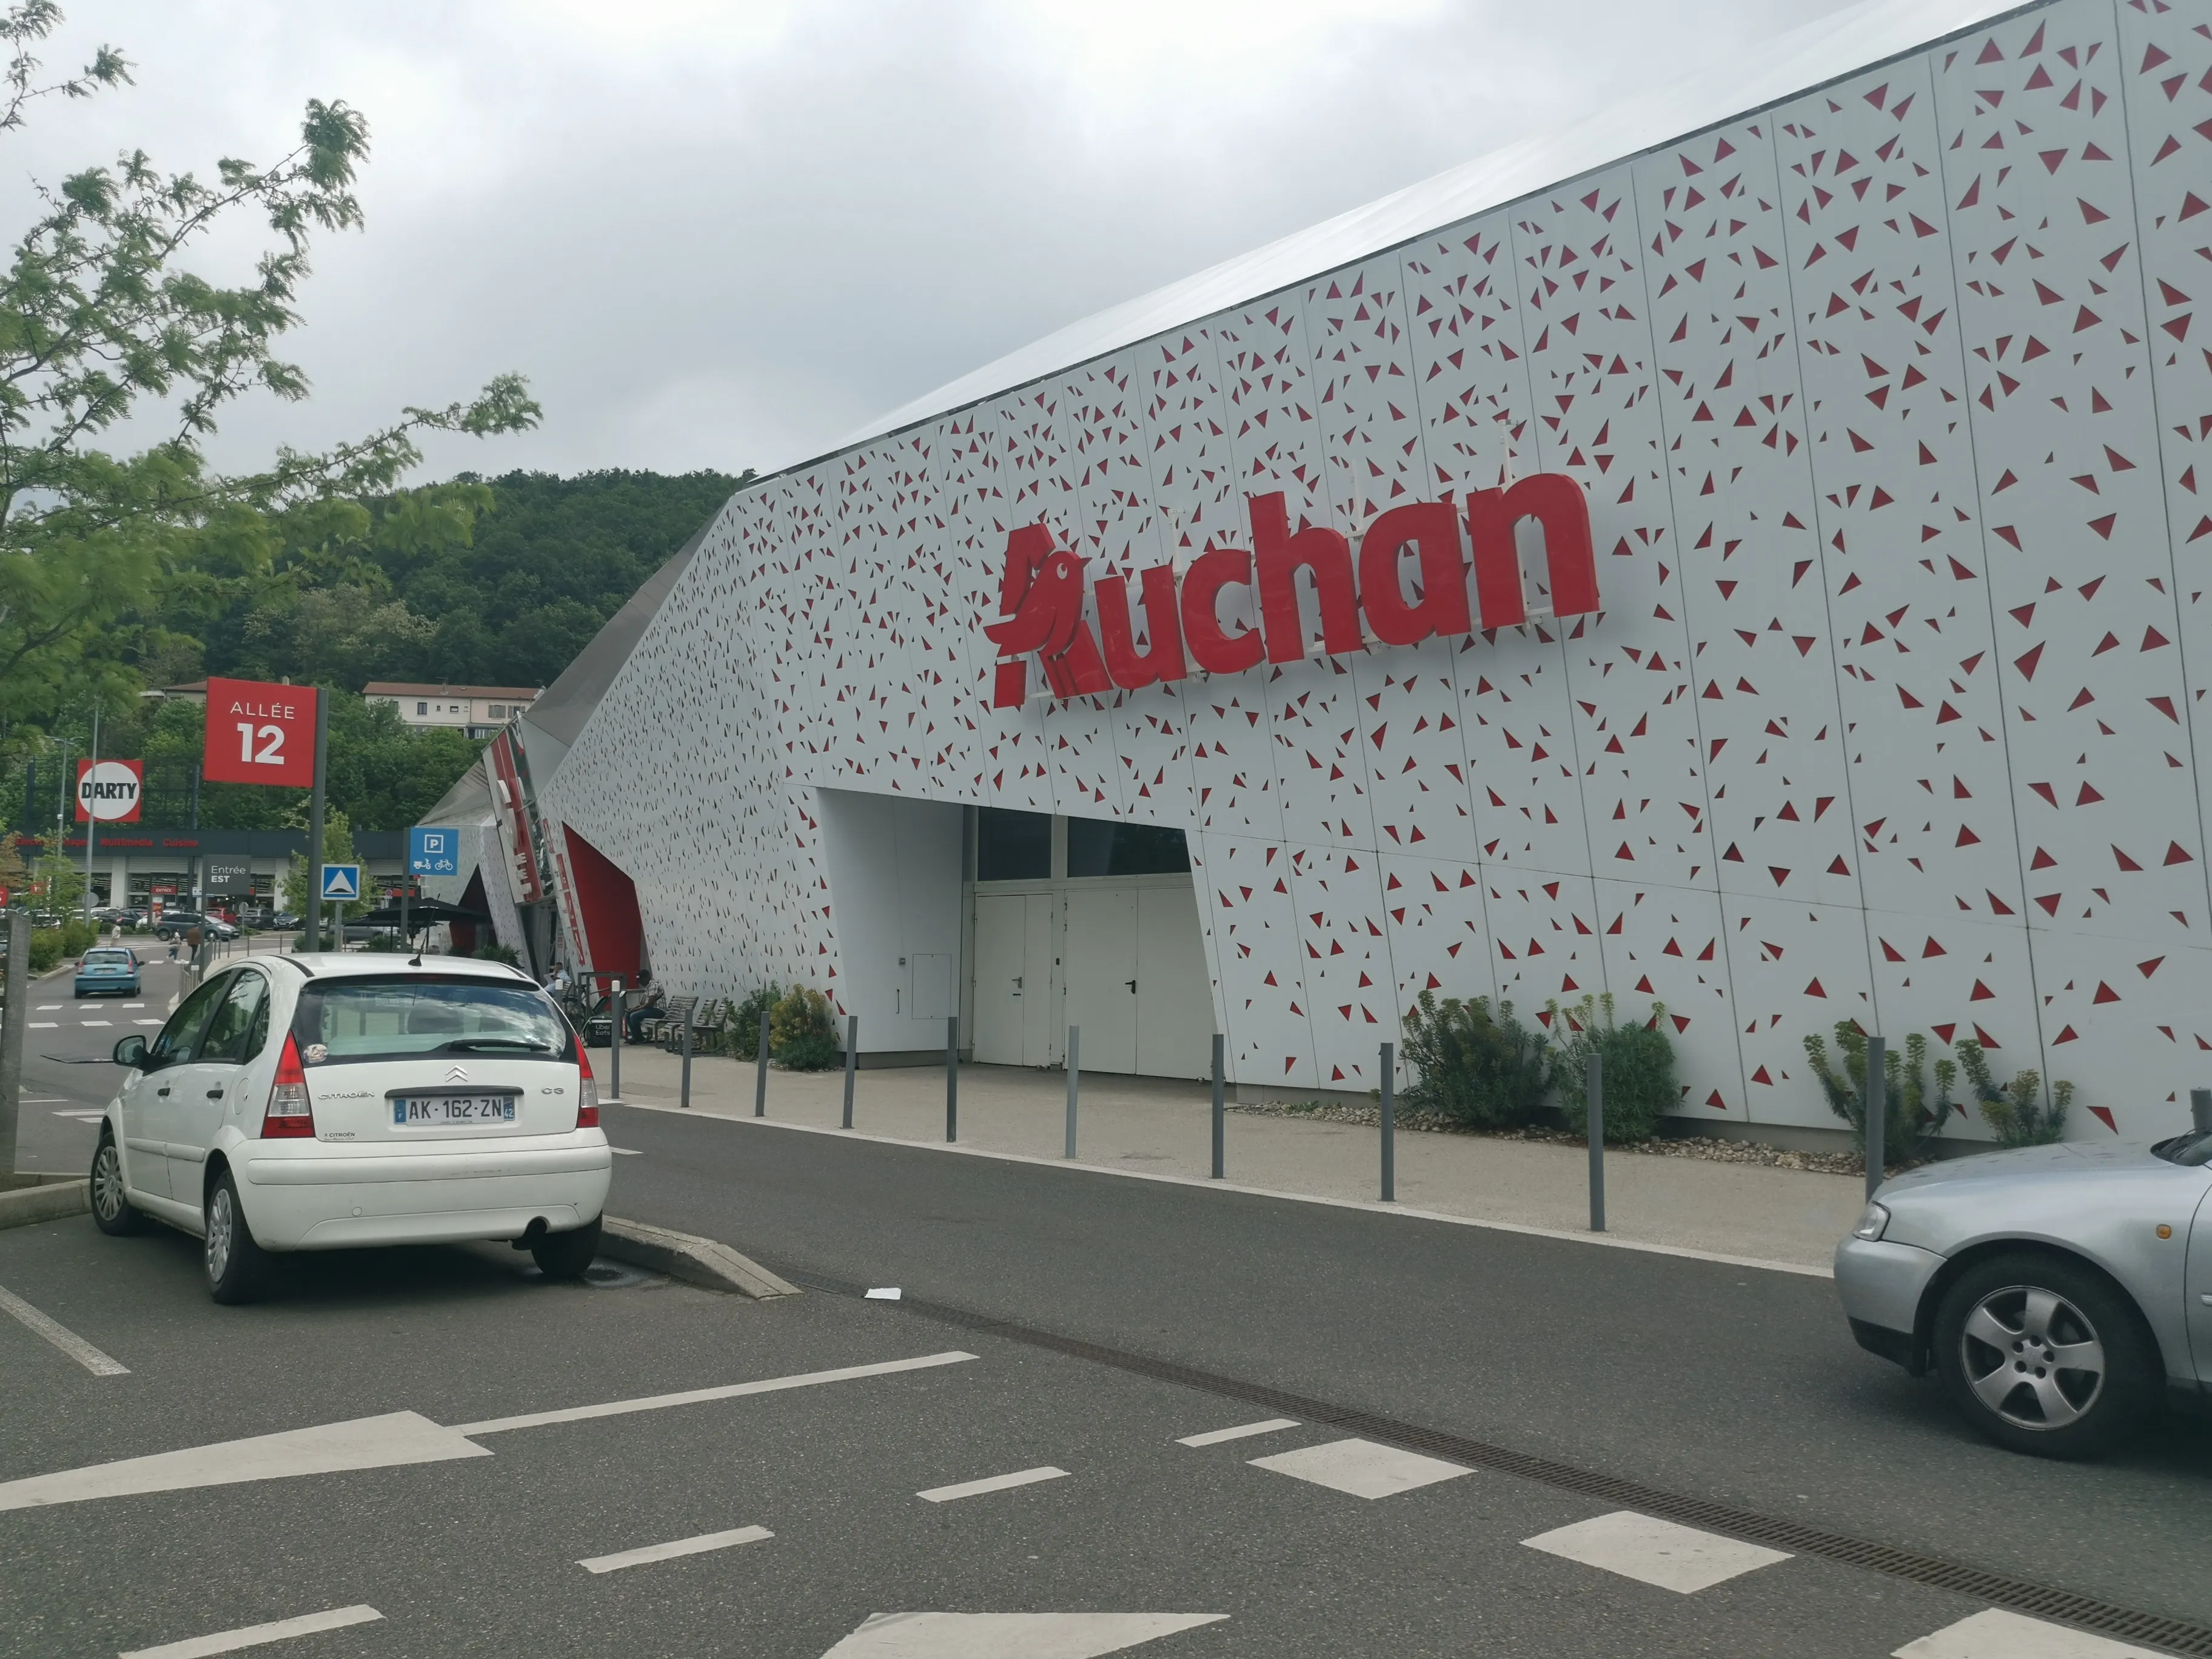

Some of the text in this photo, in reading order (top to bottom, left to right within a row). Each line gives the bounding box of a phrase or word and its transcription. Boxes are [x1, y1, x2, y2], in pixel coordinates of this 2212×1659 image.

[983, 472, 1600, 708] Auchan
[230, 701, 295, 719] ALLÉE
[237, 722, 285, 765] 12
[81, 782, 137, 799] DARTY
[430, 839, 439, 848] P
[211, 865, 246, 874] Entrée
[409, 1099, 502, 1120] AK-162-ZN
[504, 1108, 514, 1118] 42
